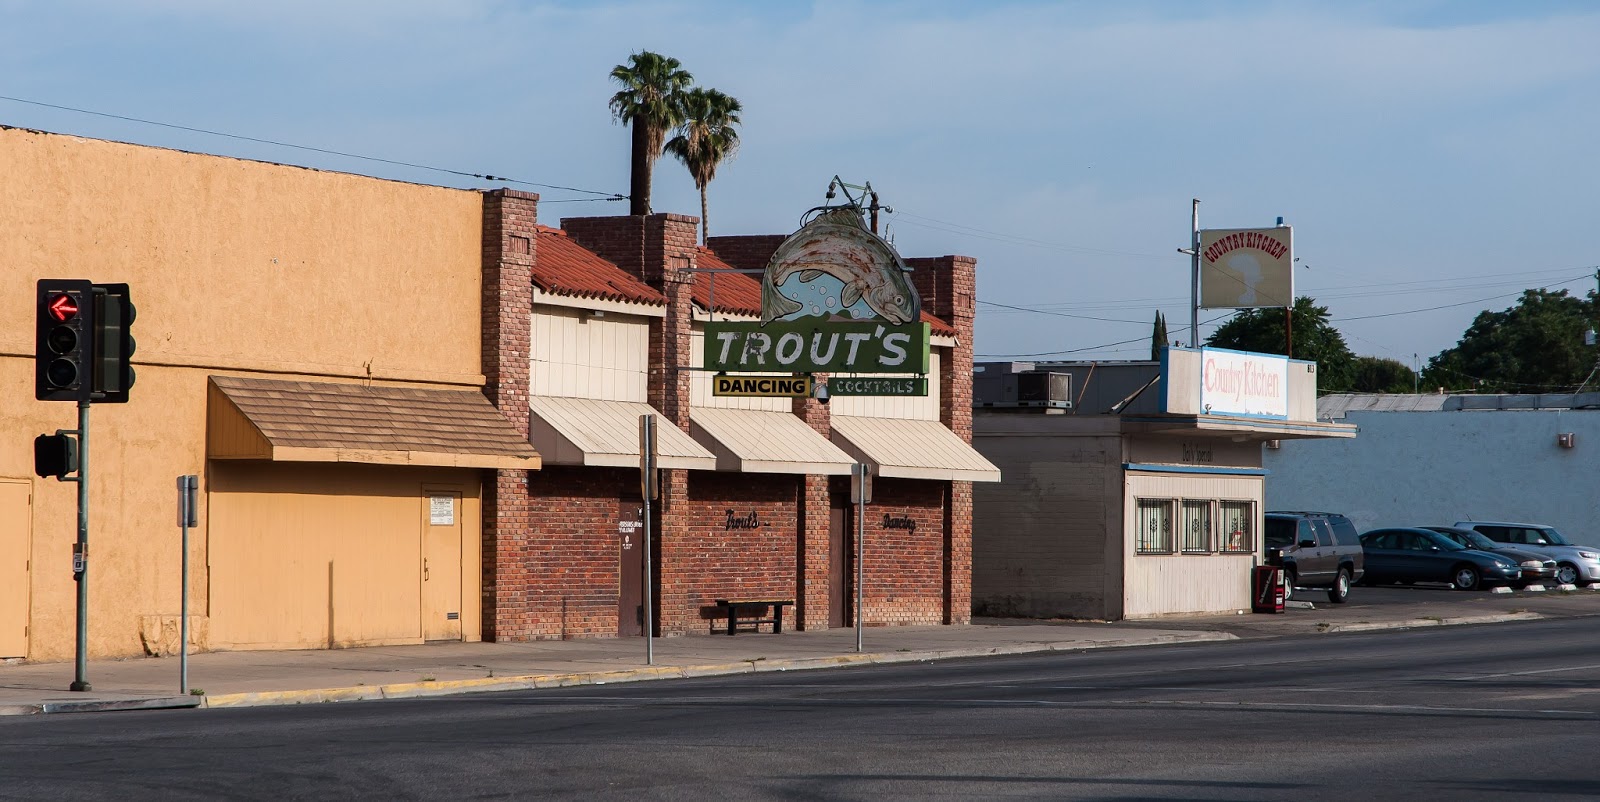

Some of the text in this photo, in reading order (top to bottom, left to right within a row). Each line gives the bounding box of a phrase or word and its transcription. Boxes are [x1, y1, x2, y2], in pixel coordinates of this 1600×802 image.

[1204, 232, 1287, 263] COUNTRY KITCHEN
[717, 324, 911, 366] TROUT'S
[719, 379, 805, 393] DANCING
[836, 380, 914, 394] COCKTAILS
[1204, 358, 1280, 402] Country Kitchen
[725, 509, 759, 531] Trout's
[882, 513, 916, 535] Dancing
